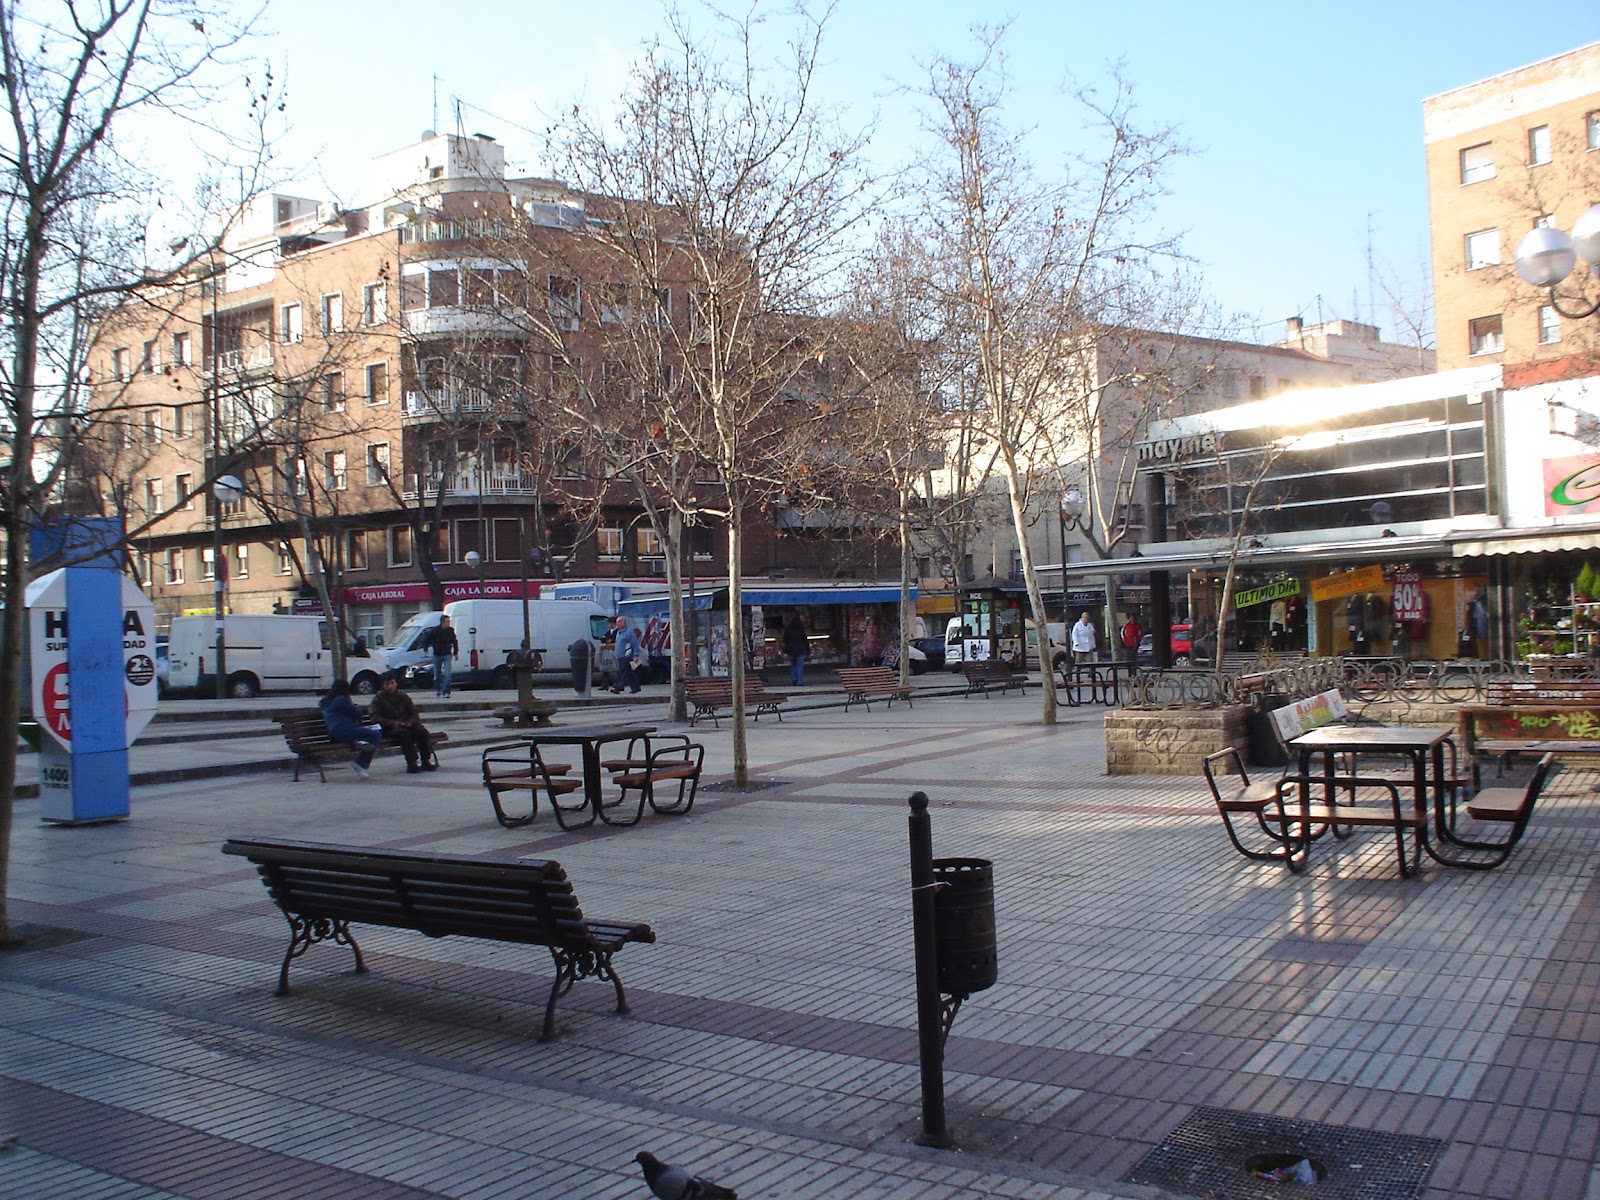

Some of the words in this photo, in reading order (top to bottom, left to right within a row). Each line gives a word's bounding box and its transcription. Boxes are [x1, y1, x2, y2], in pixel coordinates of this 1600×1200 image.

[1396, 573, 1419, 582] TODO
[377, 591, 405, 599] LABORAL
[444, 587, 467, 596] CAJA
[1394, 583, 1423, 611] 50%
